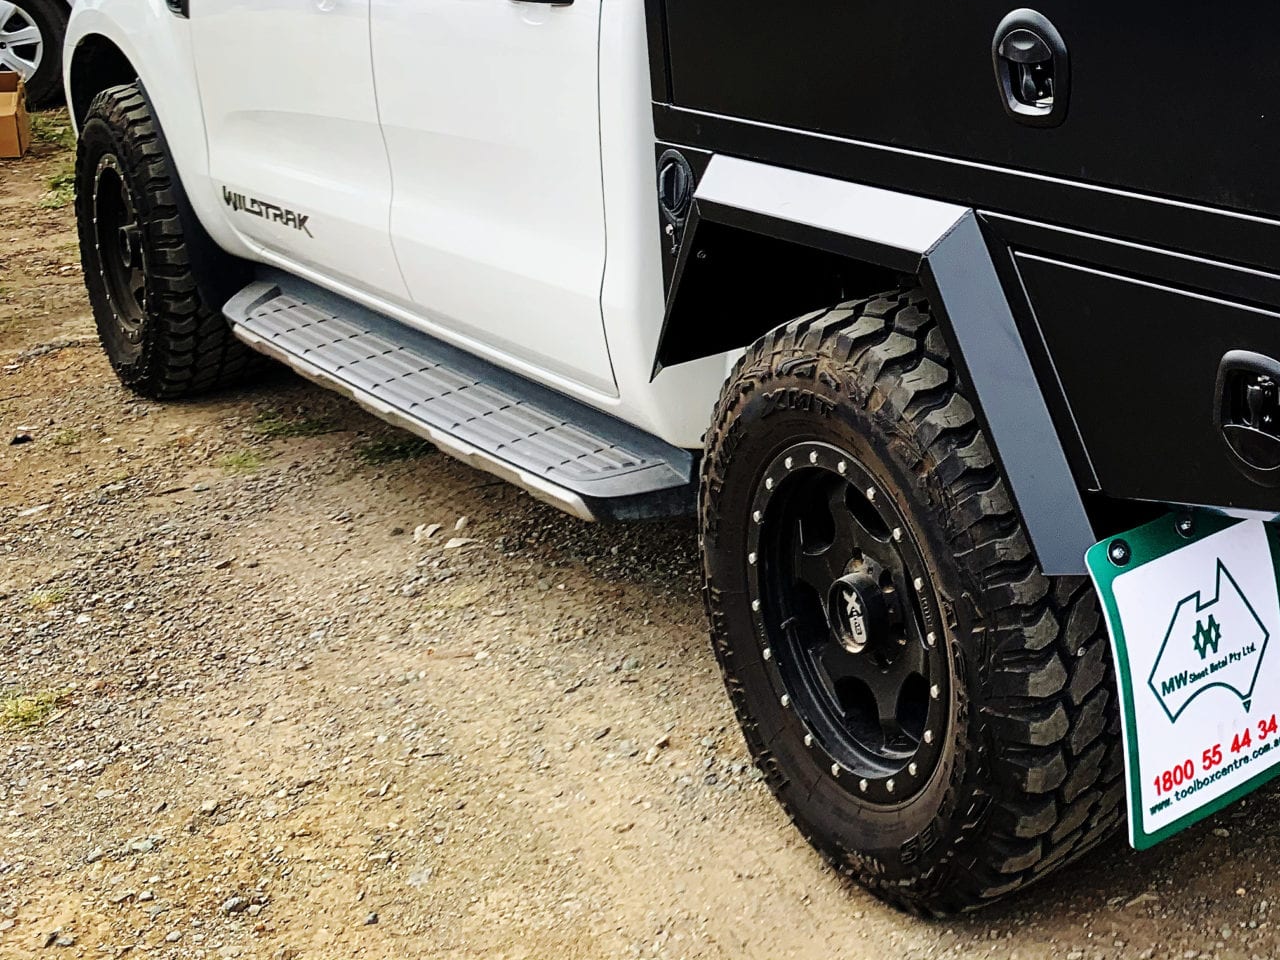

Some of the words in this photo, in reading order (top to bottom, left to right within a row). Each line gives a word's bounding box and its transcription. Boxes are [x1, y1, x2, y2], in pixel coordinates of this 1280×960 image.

[222, 185, 314, 238] WILDTRAK
[1161, 670, 1188, 697] MW
[1229, 651, 1241, 664] Pty
[1154, 759, 1195, 797] 1800
[1202, 744, 1223, 771] 55
[1231, 728, 1252, 753] 44
[1257, 714, 1278, 740] 34
